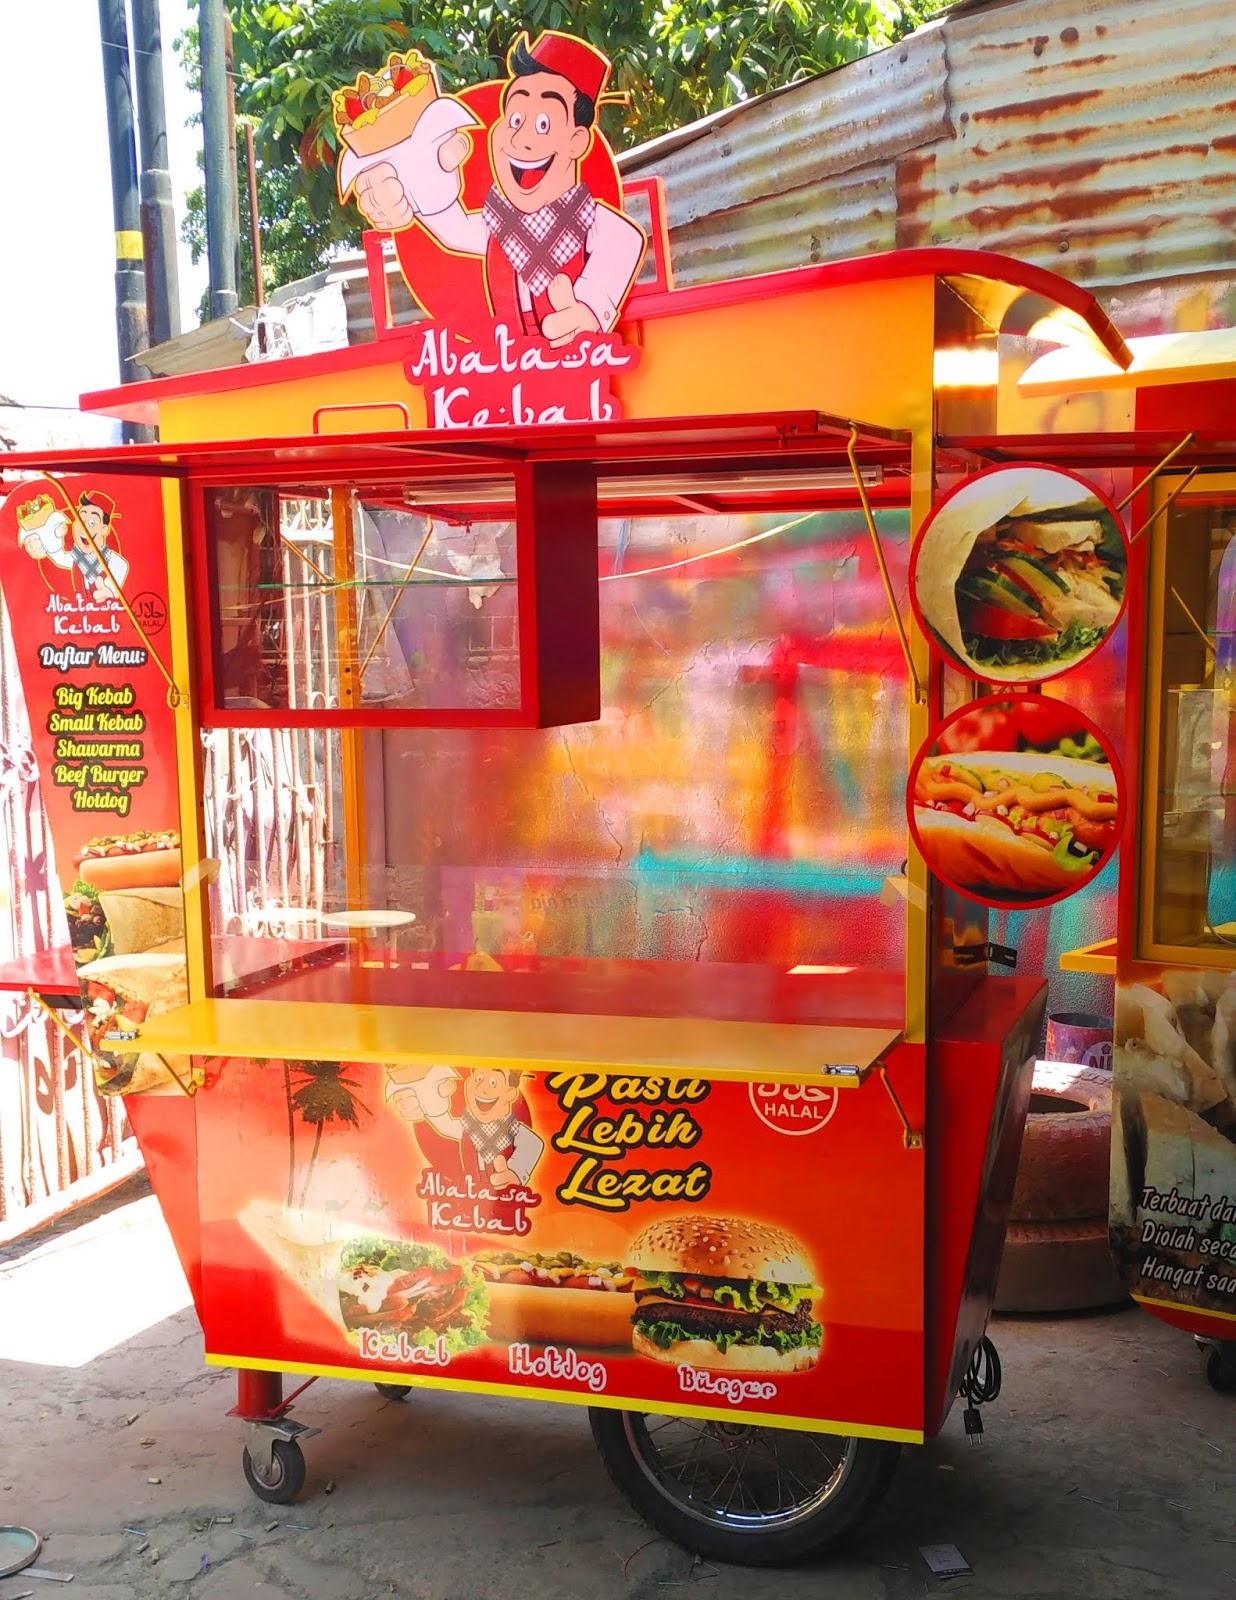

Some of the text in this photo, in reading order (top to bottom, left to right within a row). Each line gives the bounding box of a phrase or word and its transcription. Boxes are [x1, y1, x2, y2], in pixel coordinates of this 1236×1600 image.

[412, 323, 631, 377] Abatasa
[432, 377, 613, 428] Kebab
[46, 593, 127, 613] Abatasa
[54, 614, 120, 634] Kebab
[40, 645, 146, 671] Daftar Menu:
[56, 687, 133, 710] Big Kebab
[49, 713, 143, 732] Small Kebab
[56, 739, 141, 758] Shawarma
[54, 764, 145, 786] Beef Burger
[73, 790, 129, 814] Hotdog
[764, 1102, 824, 1120] HALAL
[555, 1105, 697, 1155] Lebih
[420, 1171, 538, 1203] Abatasa
[560, 1157, 707, 1207] Lezat
[431, 1201, 528, 1233] Kebab
[1142, 1188, 1210, 1218] Terbuat
[1142, 1220, 1195, 1250] Diolah
[1141, 1256, 1205, 1290] Hangat
[358, 1328, 451, 1367] Kebab
[508, 1343, 607, 1391] Hotdog
